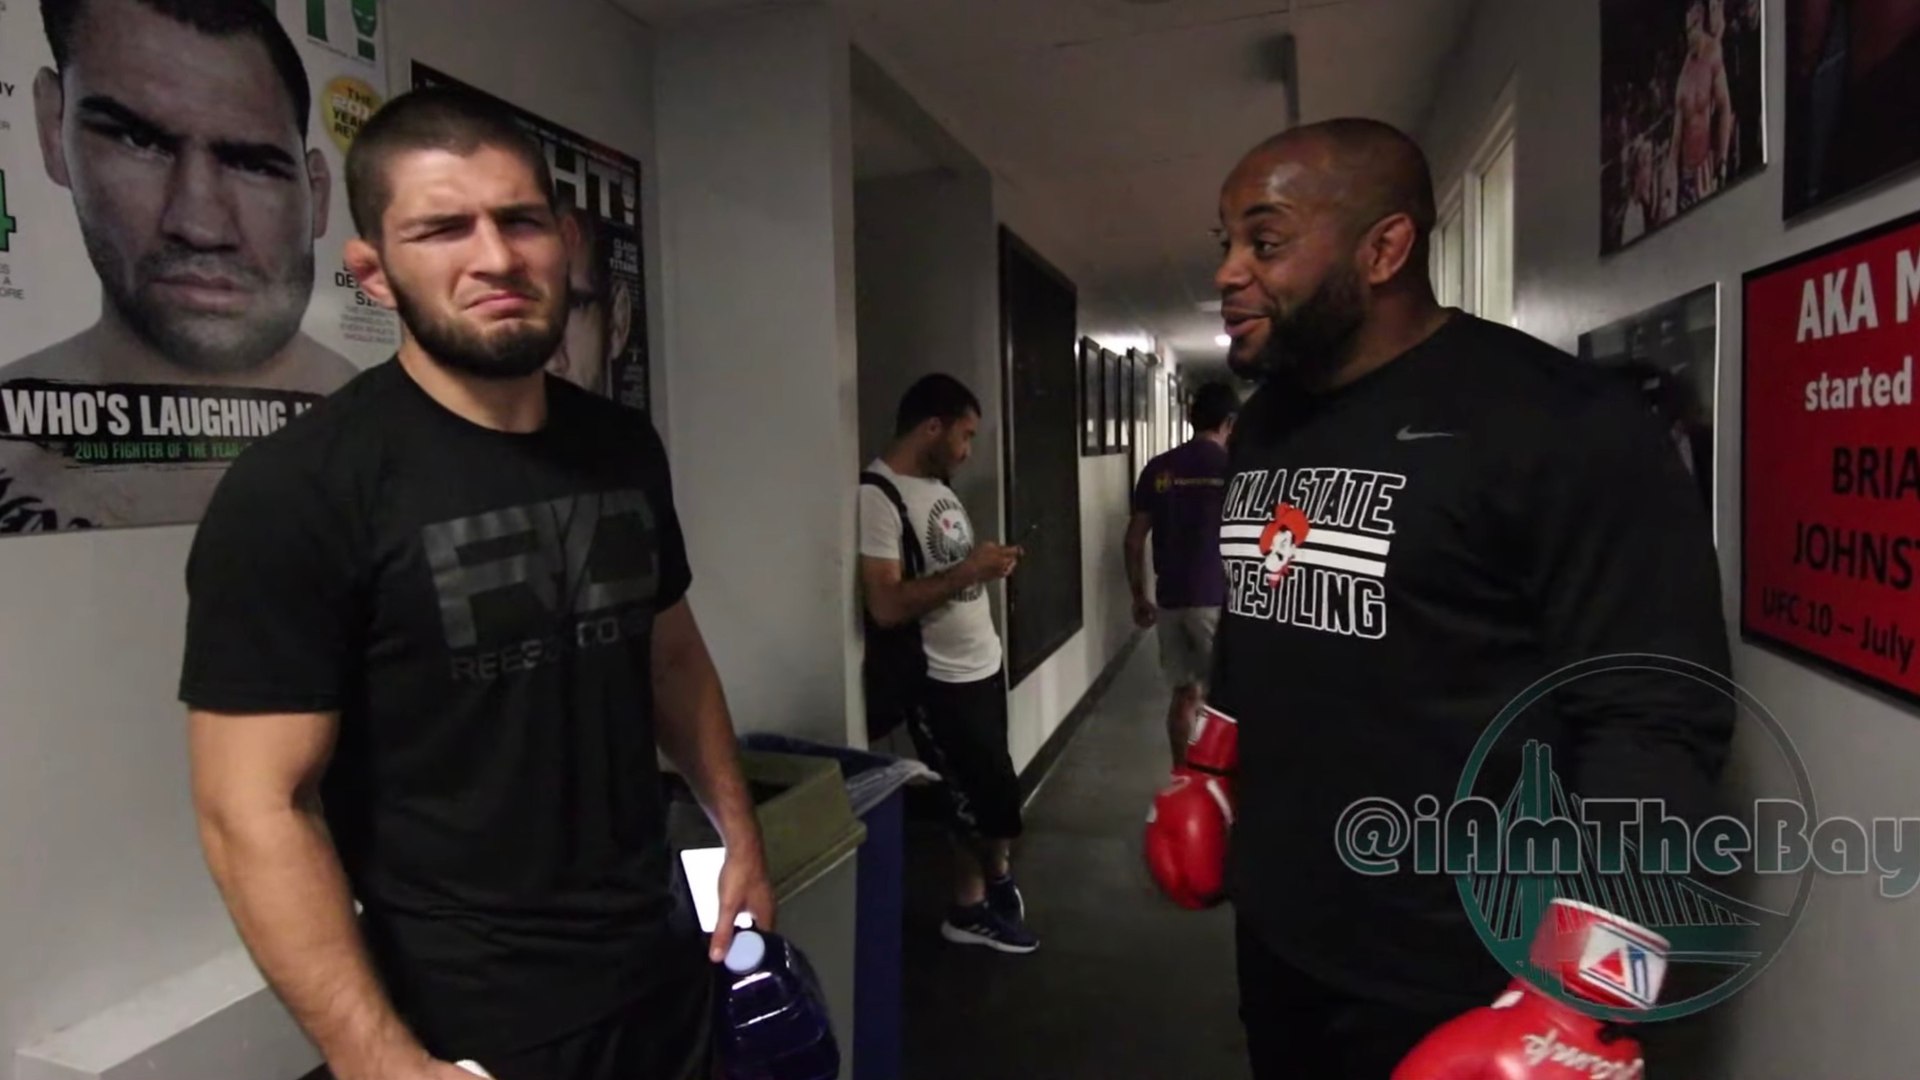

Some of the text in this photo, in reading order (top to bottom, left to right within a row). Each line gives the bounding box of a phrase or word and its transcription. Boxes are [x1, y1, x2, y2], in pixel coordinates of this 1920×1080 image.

[1797, 261, 1878, 343] AKA
[1, 388, 288, 437] WHO'S LAUGHING
[1805, 355, 1913, 411] started
[75, 442, 108, 460] 2010
[112, 442, 164, 459] FIGHTER
[167, 442, 185, 459] OF
[187, 442, 210, 458] THE
[1793, 520, 1920, 592] JOHNS
[1762, 586, 1799, 626] UFC
[1807, 602, 1833, 636] 10
[1860, 616, 1915, 675] July
